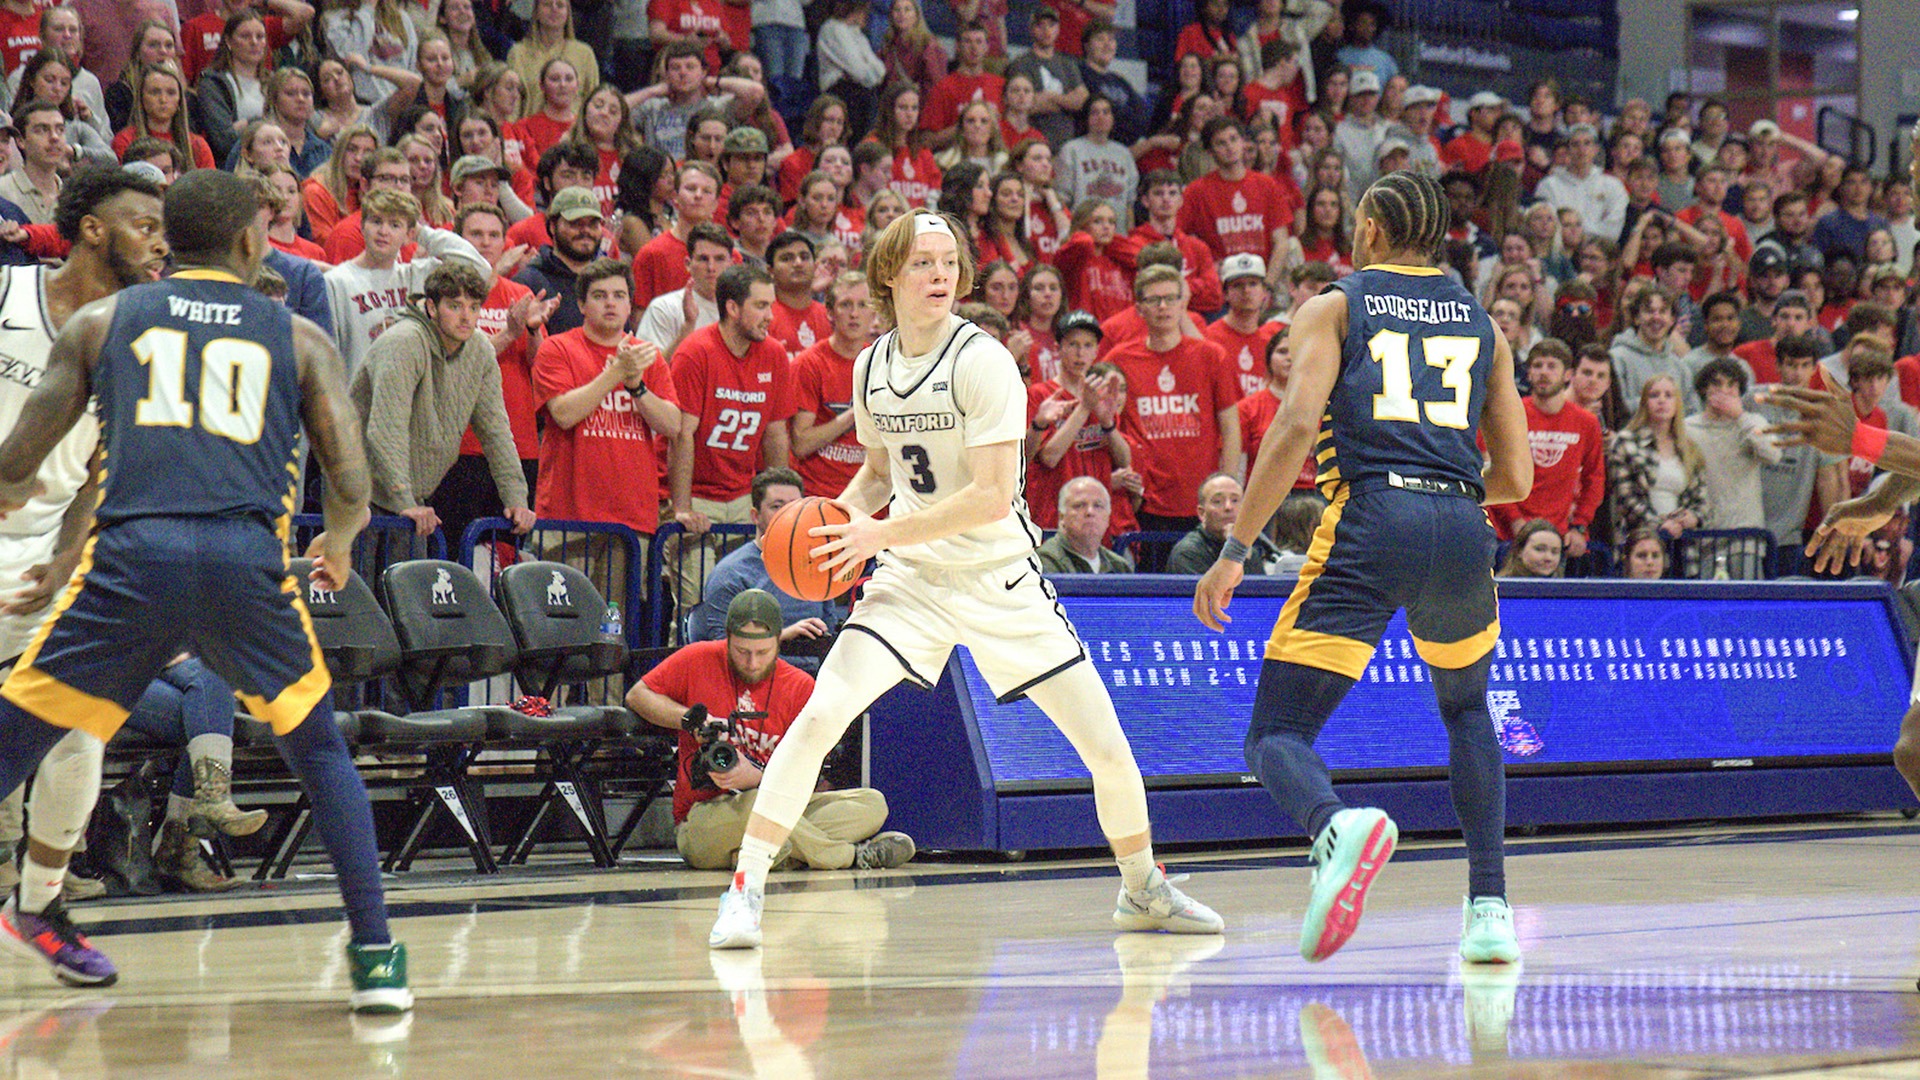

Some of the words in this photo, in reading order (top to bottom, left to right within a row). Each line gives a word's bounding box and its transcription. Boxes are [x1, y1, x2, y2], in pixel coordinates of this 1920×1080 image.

[167, 294, 242, 326] WHITE
[1364, 294, 1472, 325] COURSEAULT
[130, 325, 272, 445] 10
[1367, 328, 1481, 431] 13
[1137, 393, 1200, 417] BUCK
[705, 408, 762, 452] 22
[873, 411, 957, 434] SAMFORD
[901, 445, 937, 494] 3
[1496, 637, 1646, 660] BASKETBALL
[1660, 637, 1847, 659] CHAMPIONSHIPS
[1113, 667, 1192, 688] MARCH
[1489, 663, 1596, 683] CHEROKEE
[441, 789, 457, 801] 26
[560, 784, 576, 796] 25
